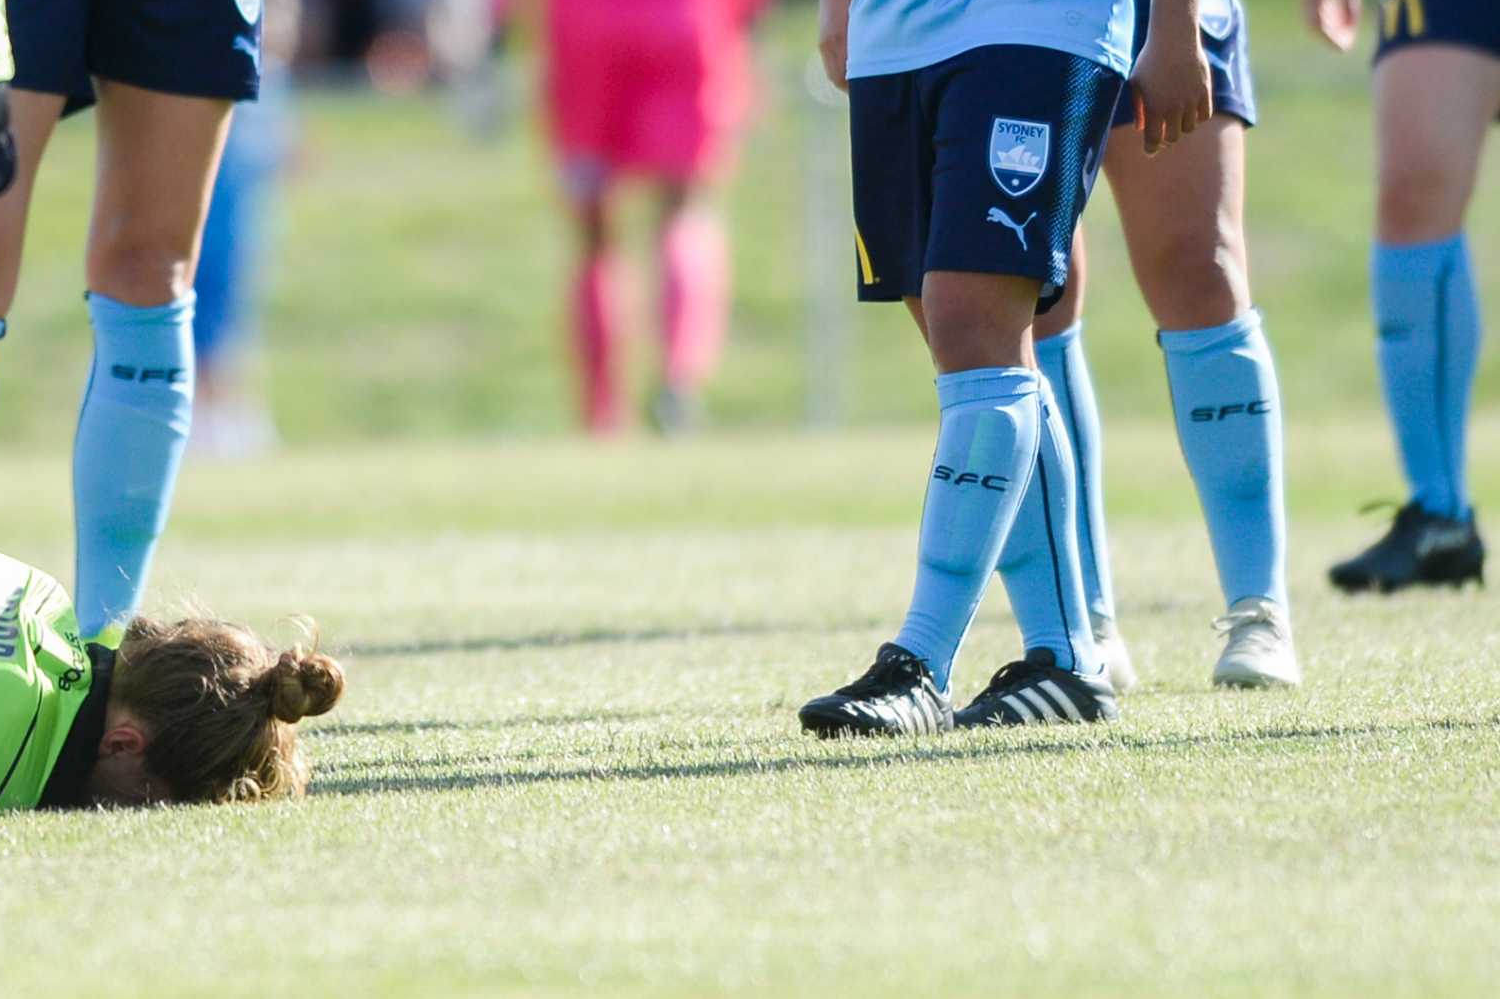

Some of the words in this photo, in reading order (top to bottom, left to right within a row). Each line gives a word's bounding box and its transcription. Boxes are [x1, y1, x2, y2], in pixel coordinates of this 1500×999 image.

[997, 122, 1045, 138] SYDNEY
[1189, 399, 1272, 422] SFC
[933, 465, 1010, 492] SFC
